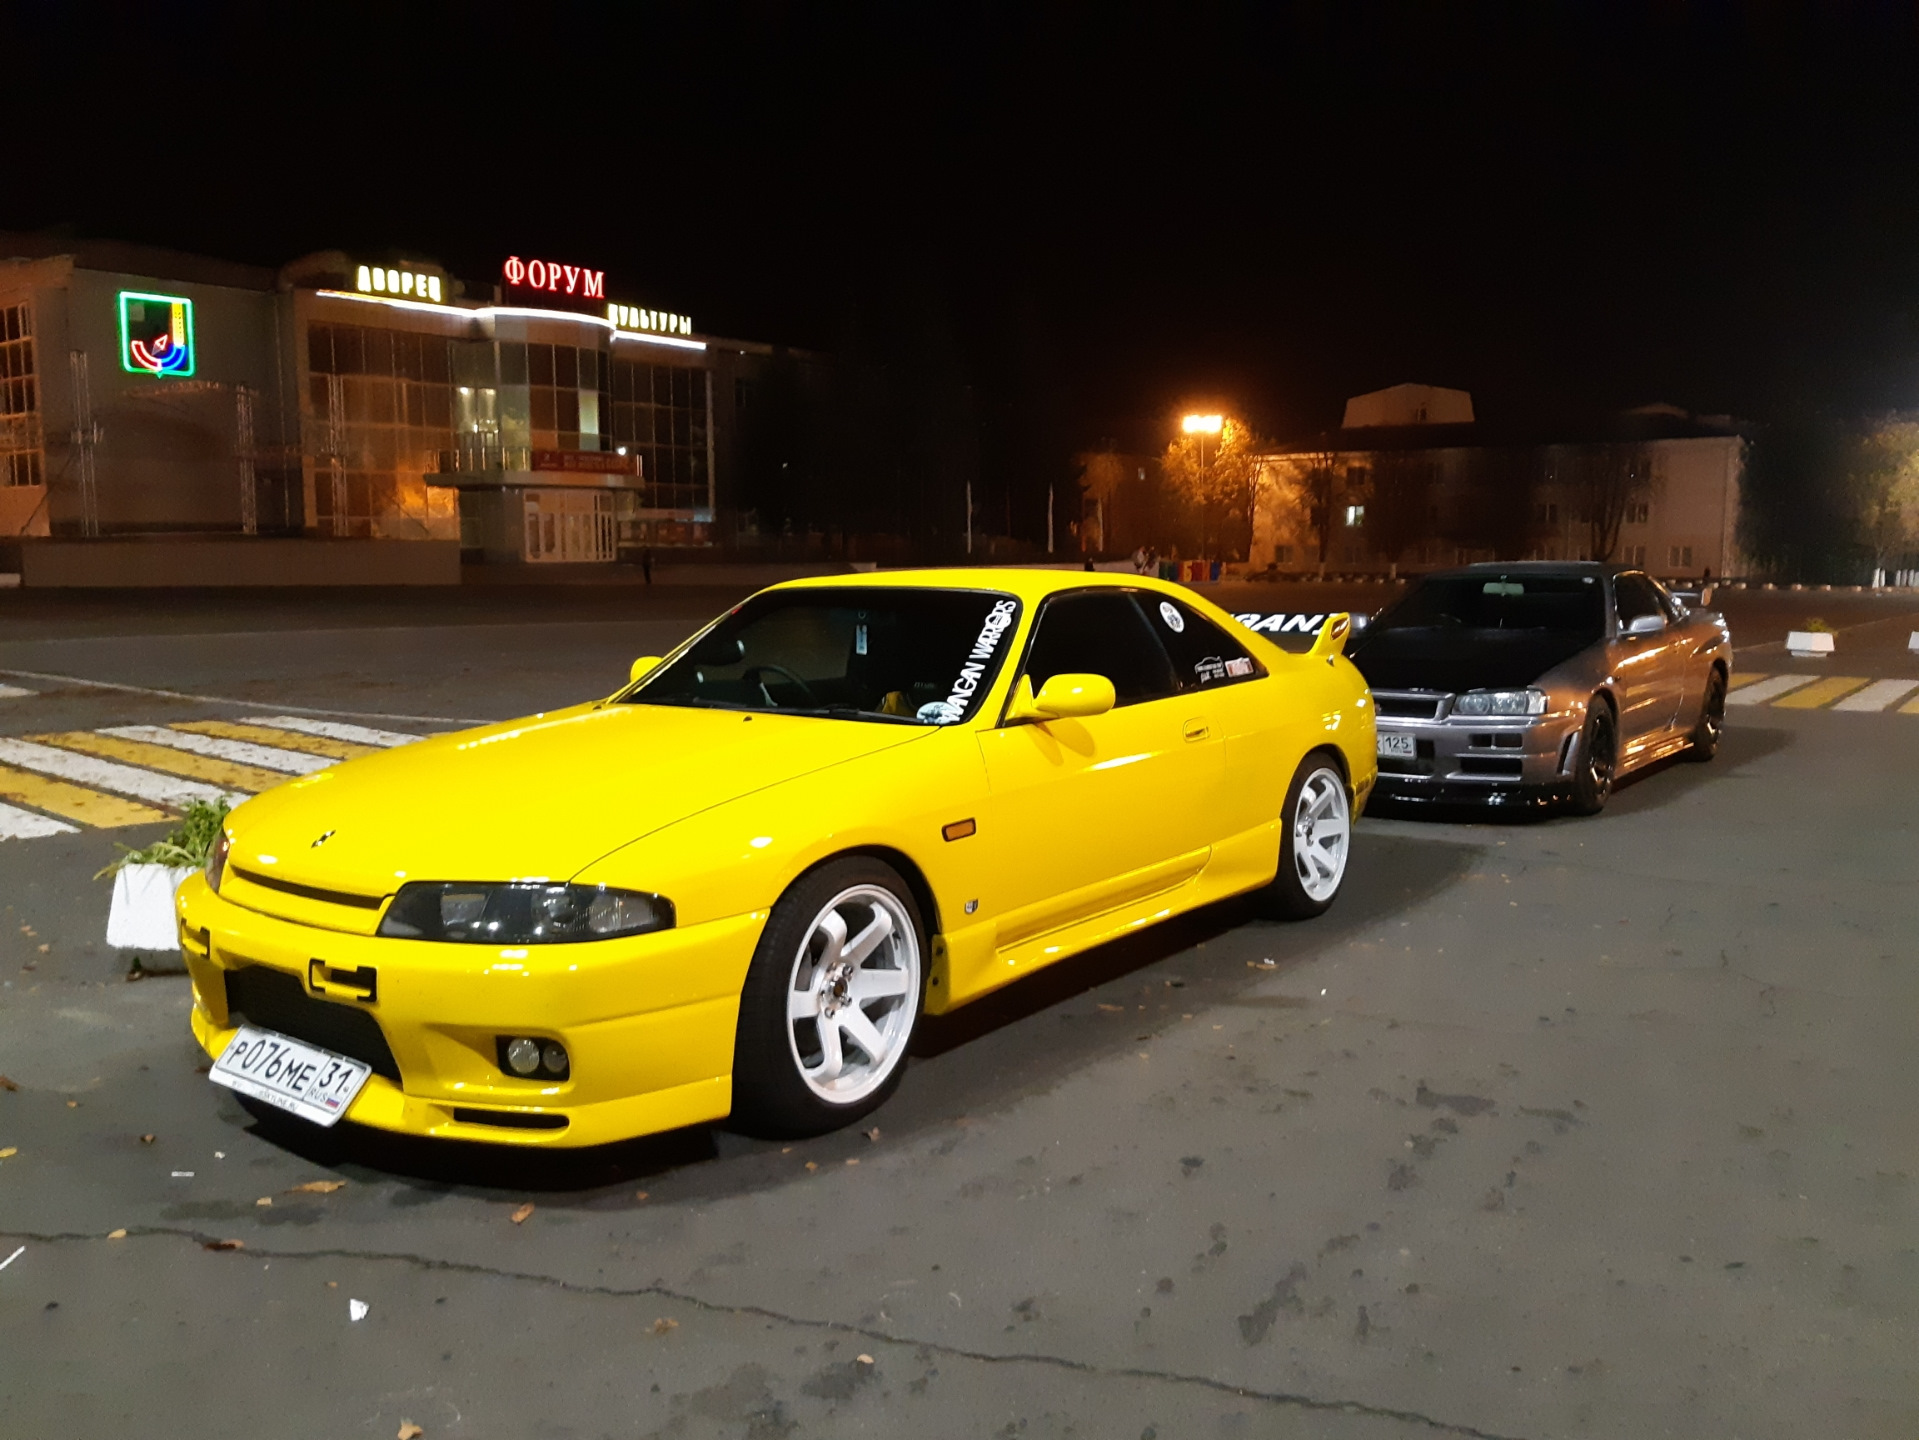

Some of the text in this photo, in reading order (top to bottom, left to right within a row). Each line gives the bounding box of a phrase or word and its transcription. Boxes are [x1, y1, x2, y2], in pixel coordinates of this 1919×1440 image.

[357, 265, 441, 302] ДВОРЕЦ
[505, 256, 605, 298] ФОРУМ
[608, 303, 692, 336] КУЛЬТУРЫ
[938, 661, 986, 722] WANGAN
[1385, 736, 1409, 750] 125
[309, 1086, 328, 1102] RUS
[319, 1062, 353, 1094] 31
